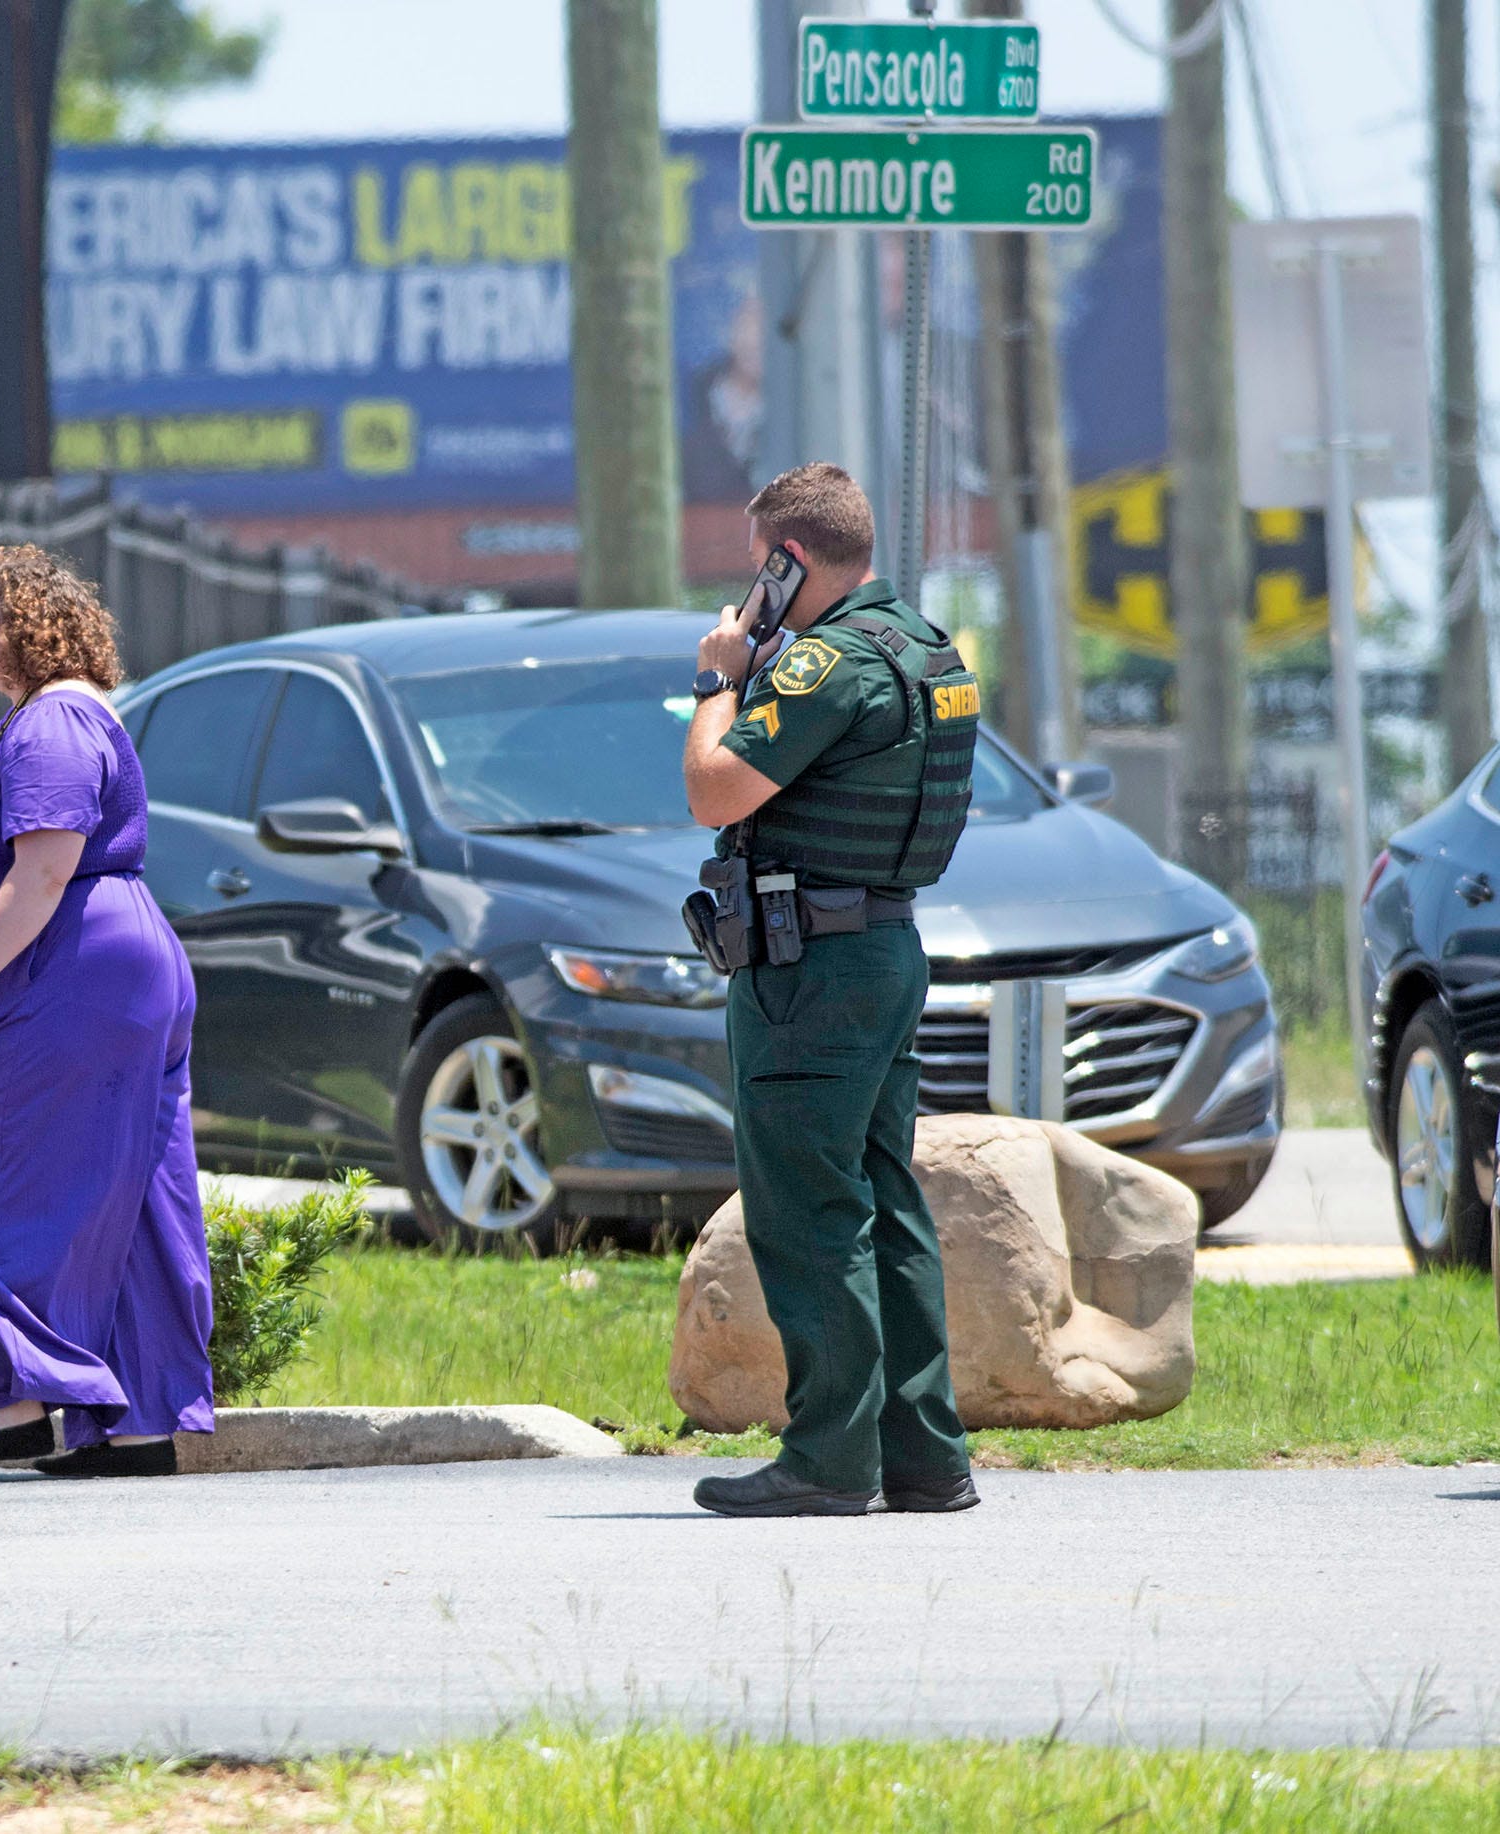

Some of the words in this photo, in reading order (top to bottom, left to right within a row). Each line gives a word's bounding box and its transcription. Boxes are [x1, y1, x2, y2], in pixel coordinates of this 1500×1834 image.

[806, 34, 965, 107] Pensacola
[1005, 36, 1036, 67] Blvd
[998, 75, 1035, 107] 6700
[49, 167, 342, 271] ERICA'S
[353, 157, 700, 267] LARGT
[753, 142, 956, 214] Kenmore
[1048, 144, 1083, 175] Rd
[1026, 183, 1082, 215] 200
[49, 276, 199, 379] URY
[211, 270, 388, 376] LAW
